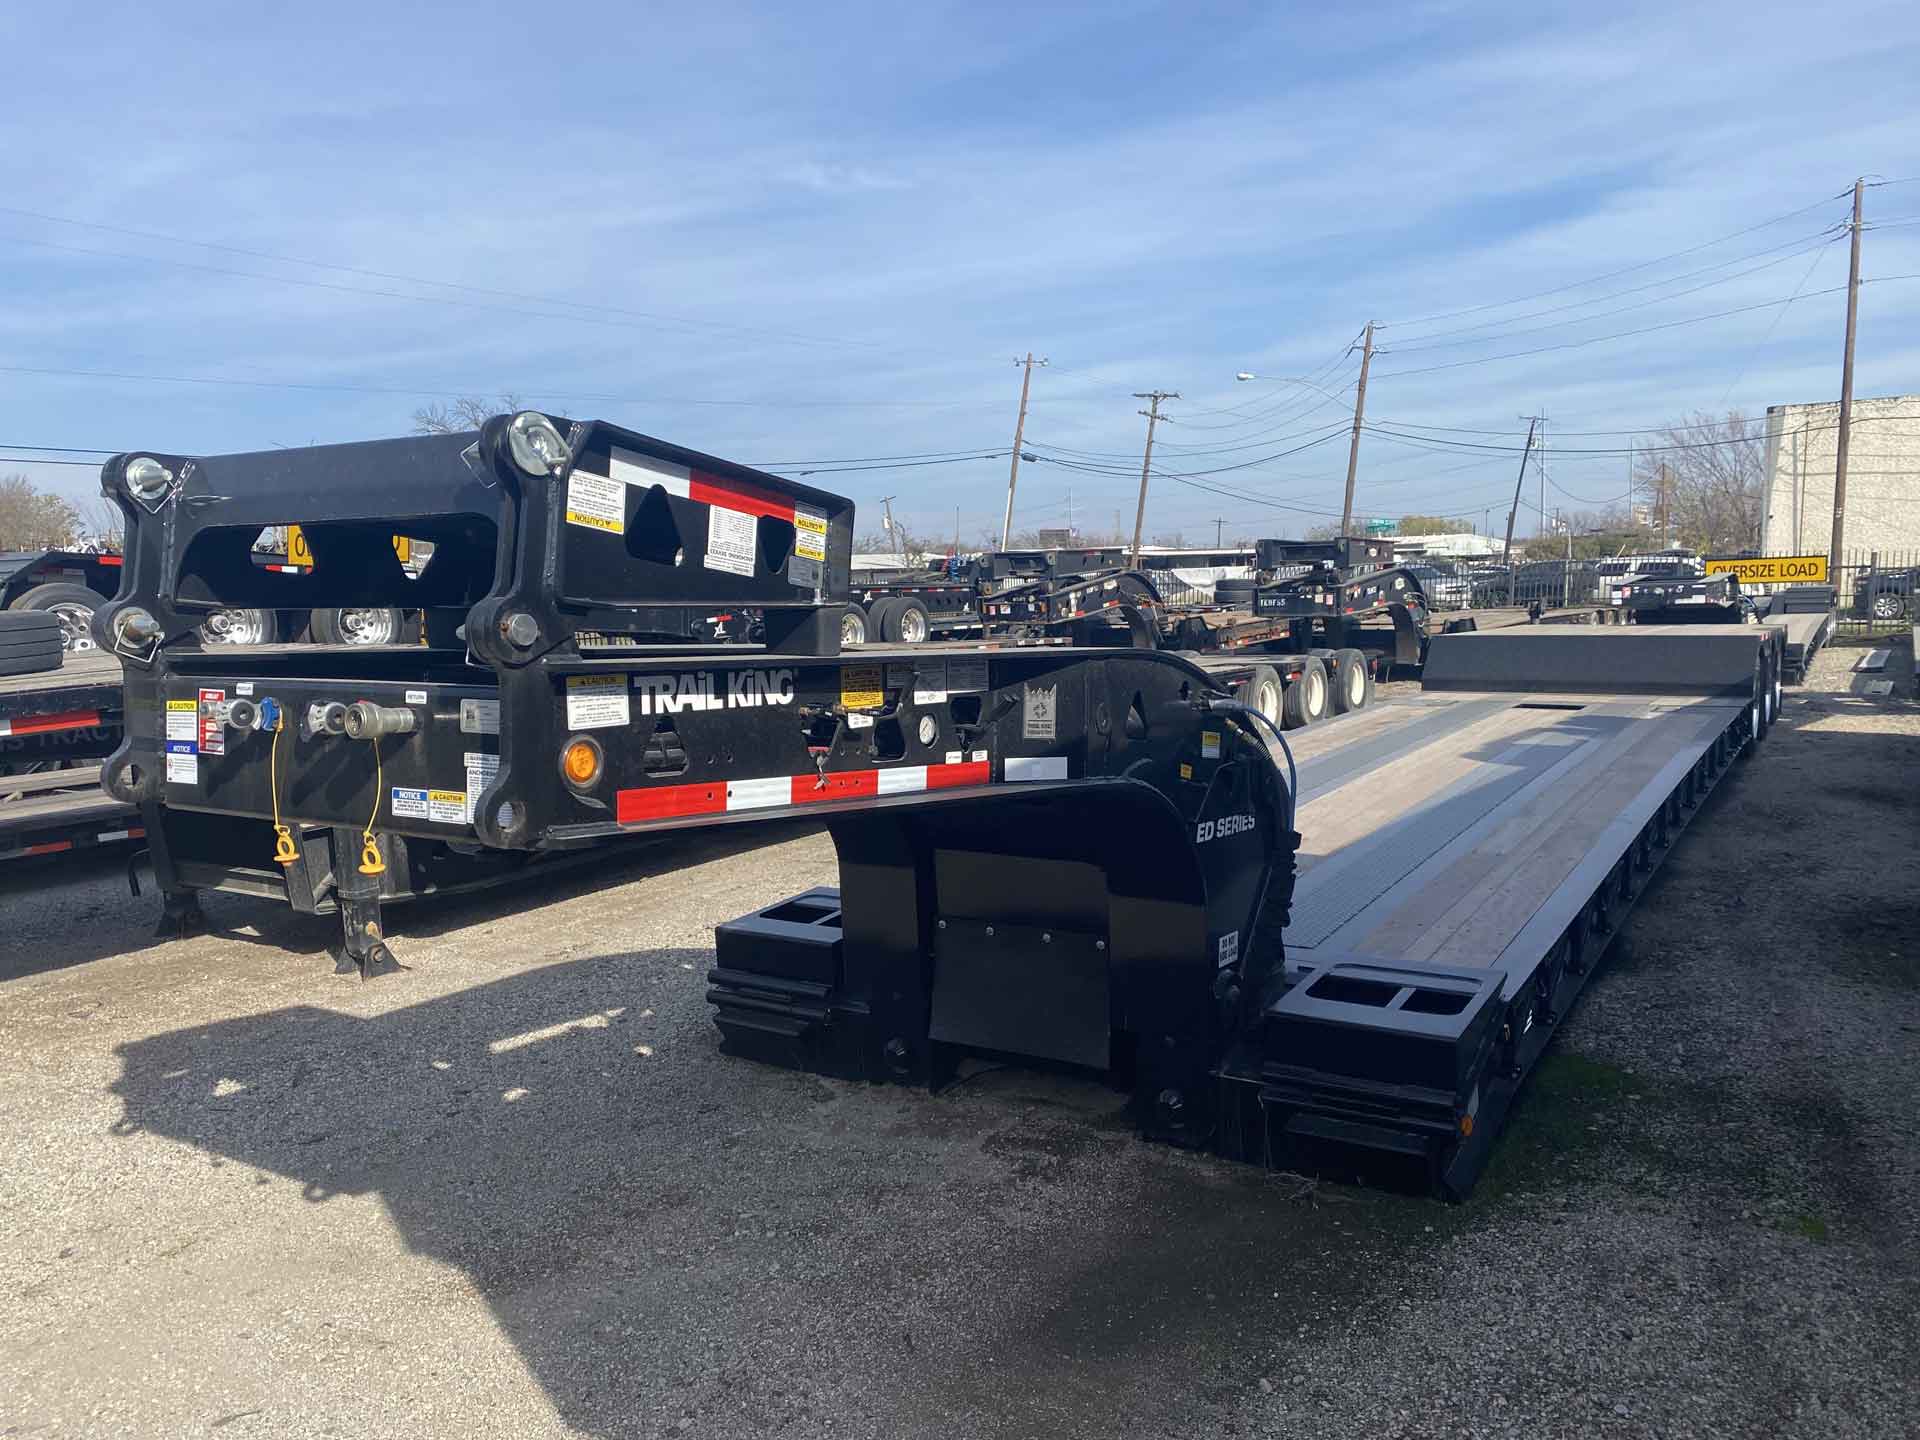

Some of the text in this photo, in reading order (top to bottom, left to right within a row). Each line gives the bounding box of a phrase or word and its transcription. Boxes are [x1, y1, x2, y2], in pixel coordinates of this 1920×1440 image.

[1780, 563, 1819, 577] LOAD
[399, 791, 421, 800] NOTICE
[1196, 814, 1256, 844] ED SERIES
